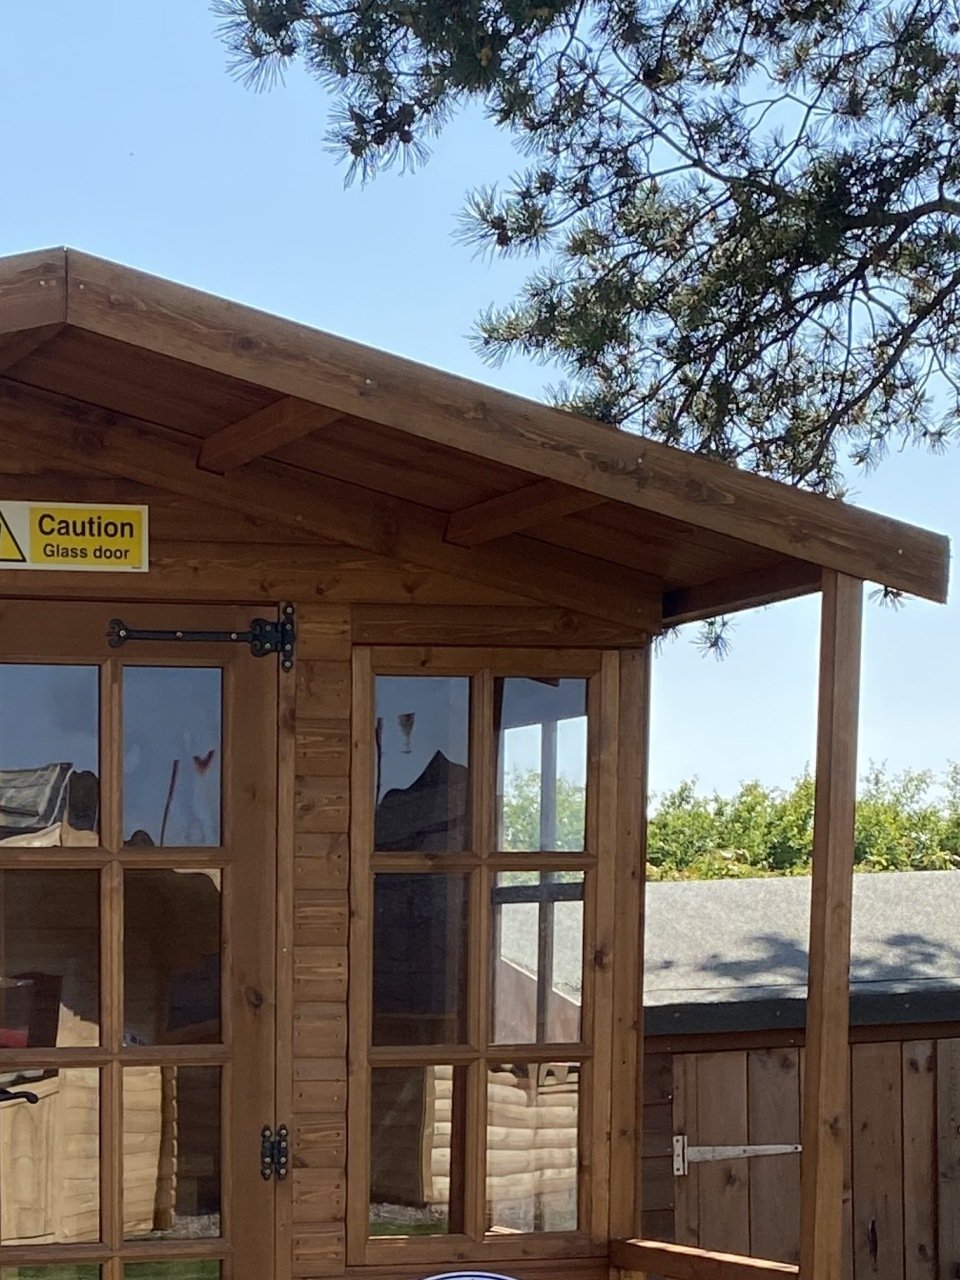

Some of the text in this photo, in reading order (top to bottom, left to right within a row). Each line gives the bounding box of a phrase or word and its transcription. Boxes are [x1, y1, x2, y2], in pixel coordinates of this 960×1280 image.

[38, 513, 134, 538] Caution
[43, 543, 130, 560] Glass door
